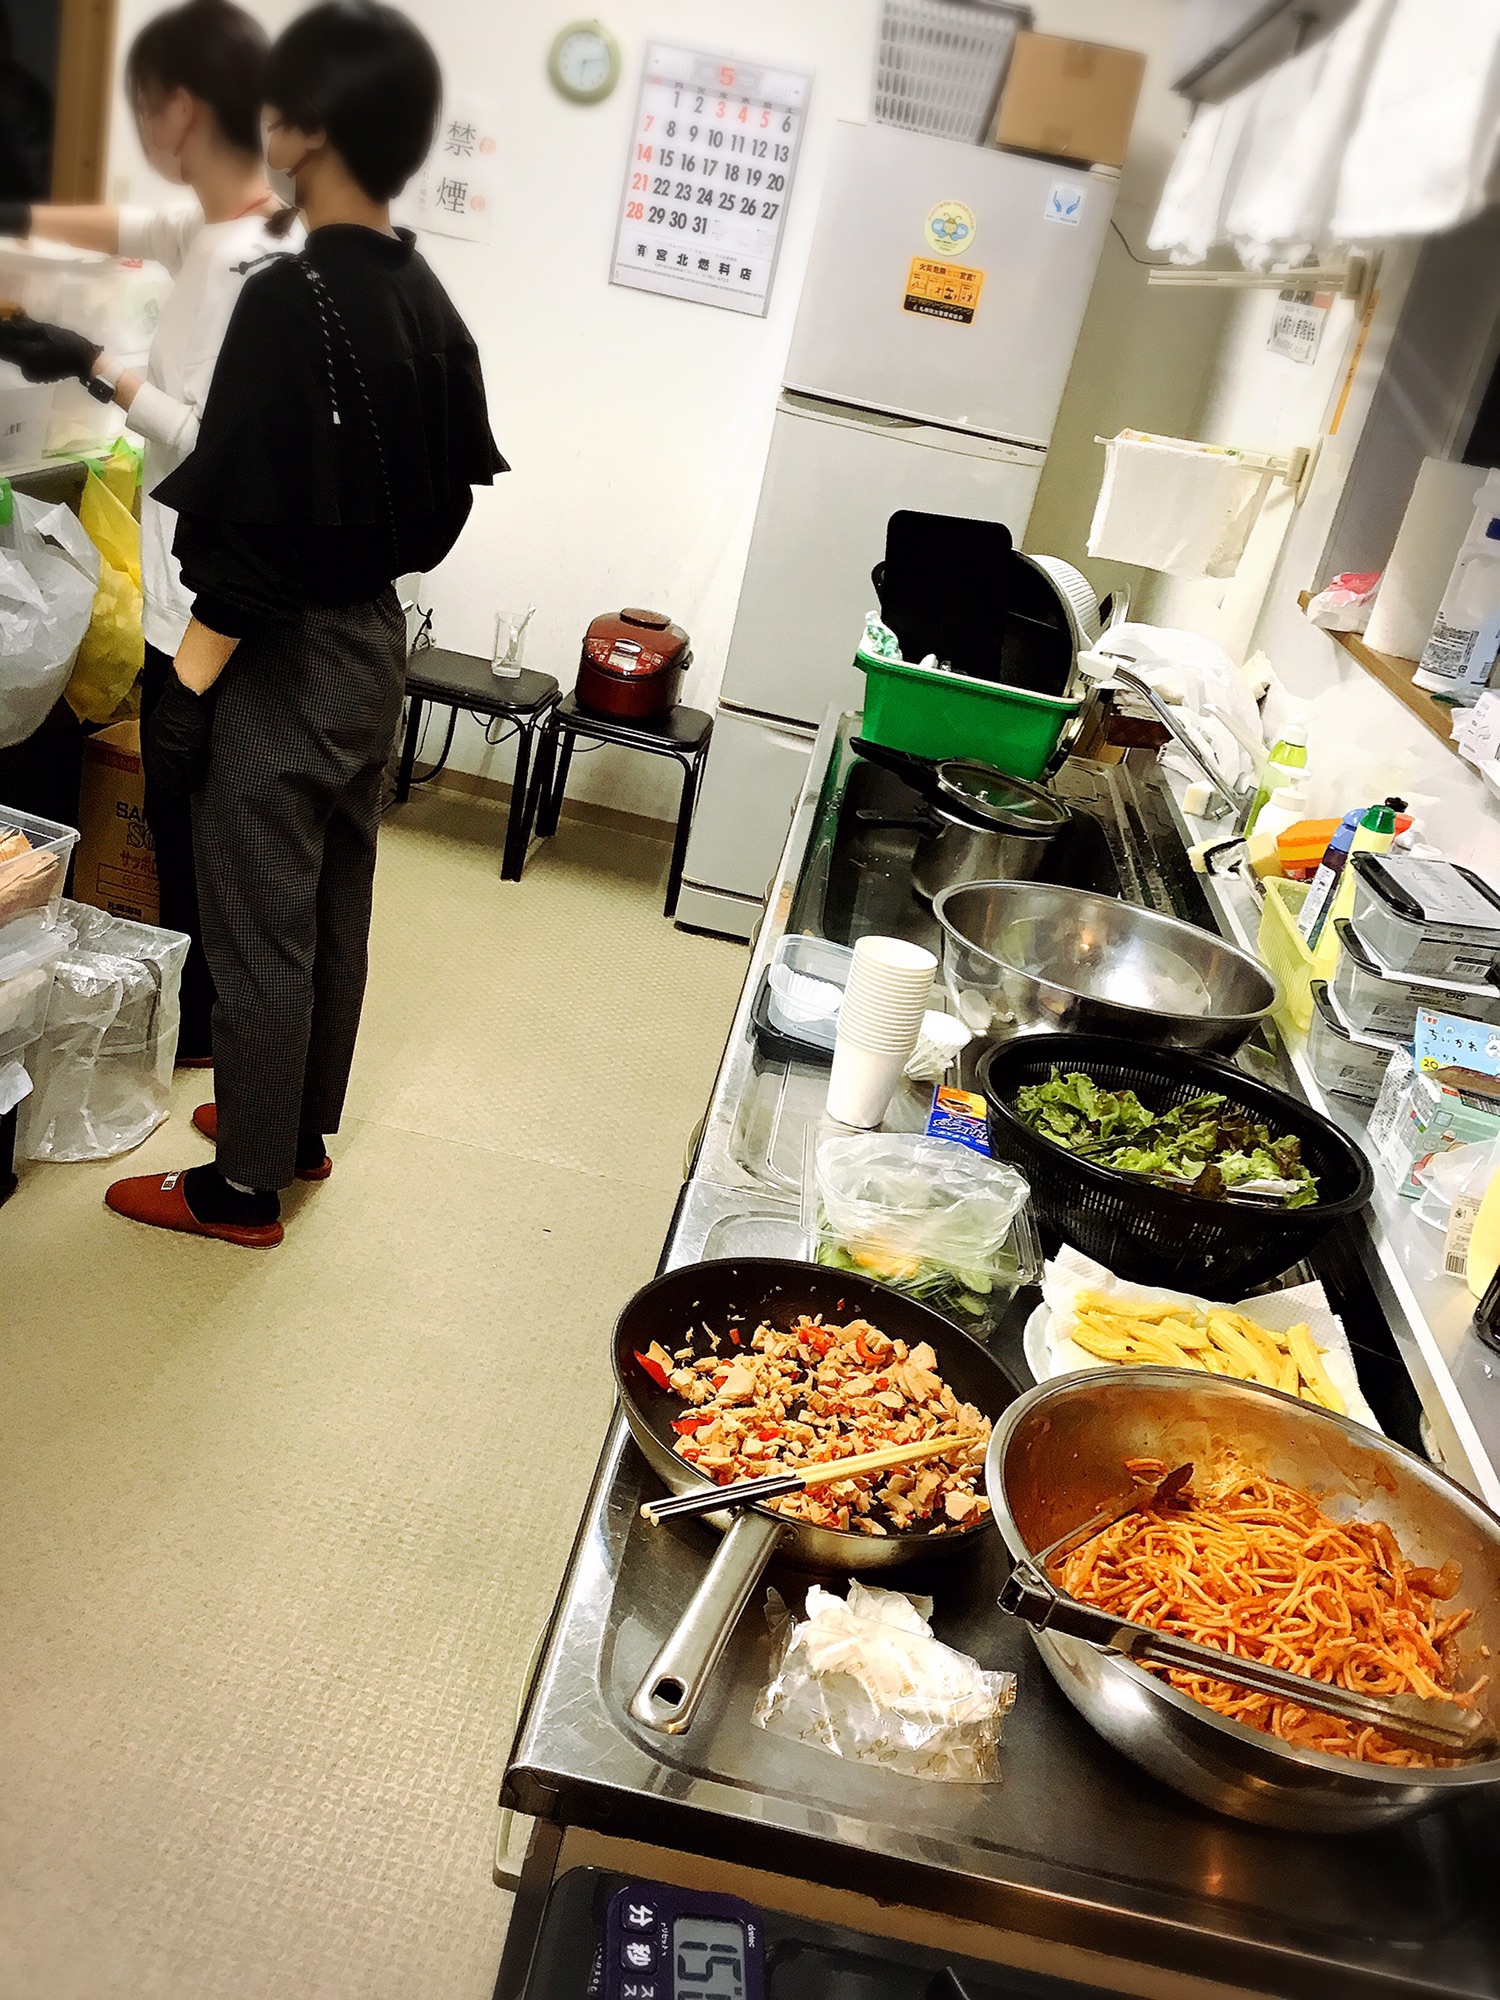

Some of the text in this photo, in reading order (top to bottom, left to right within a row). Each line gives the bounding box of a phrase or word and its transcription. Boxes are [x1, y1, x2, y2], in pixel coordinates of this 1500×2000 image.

[674, 82, 684, 90] 月
[718, 66, 736, 88] 5
[673, 91, 791, 133] 1 2 3 4 5 6
[643, 115, 789, 163] 7 8 9 10 11 12 13
[435, 120, 477, 215] 禁煙
[637, 143, 785, 192] 14 15 16 17 18 19 20
[632, 172, 779, 220] 21 22 23 24 25 26 27
[626, 201, 708, 234] 28 29 30 31
[1424, 1058, 1439, 1070] 20
[629, 1904, 653, 1927] 分
[626, 1942, 651, 1966] 秒
